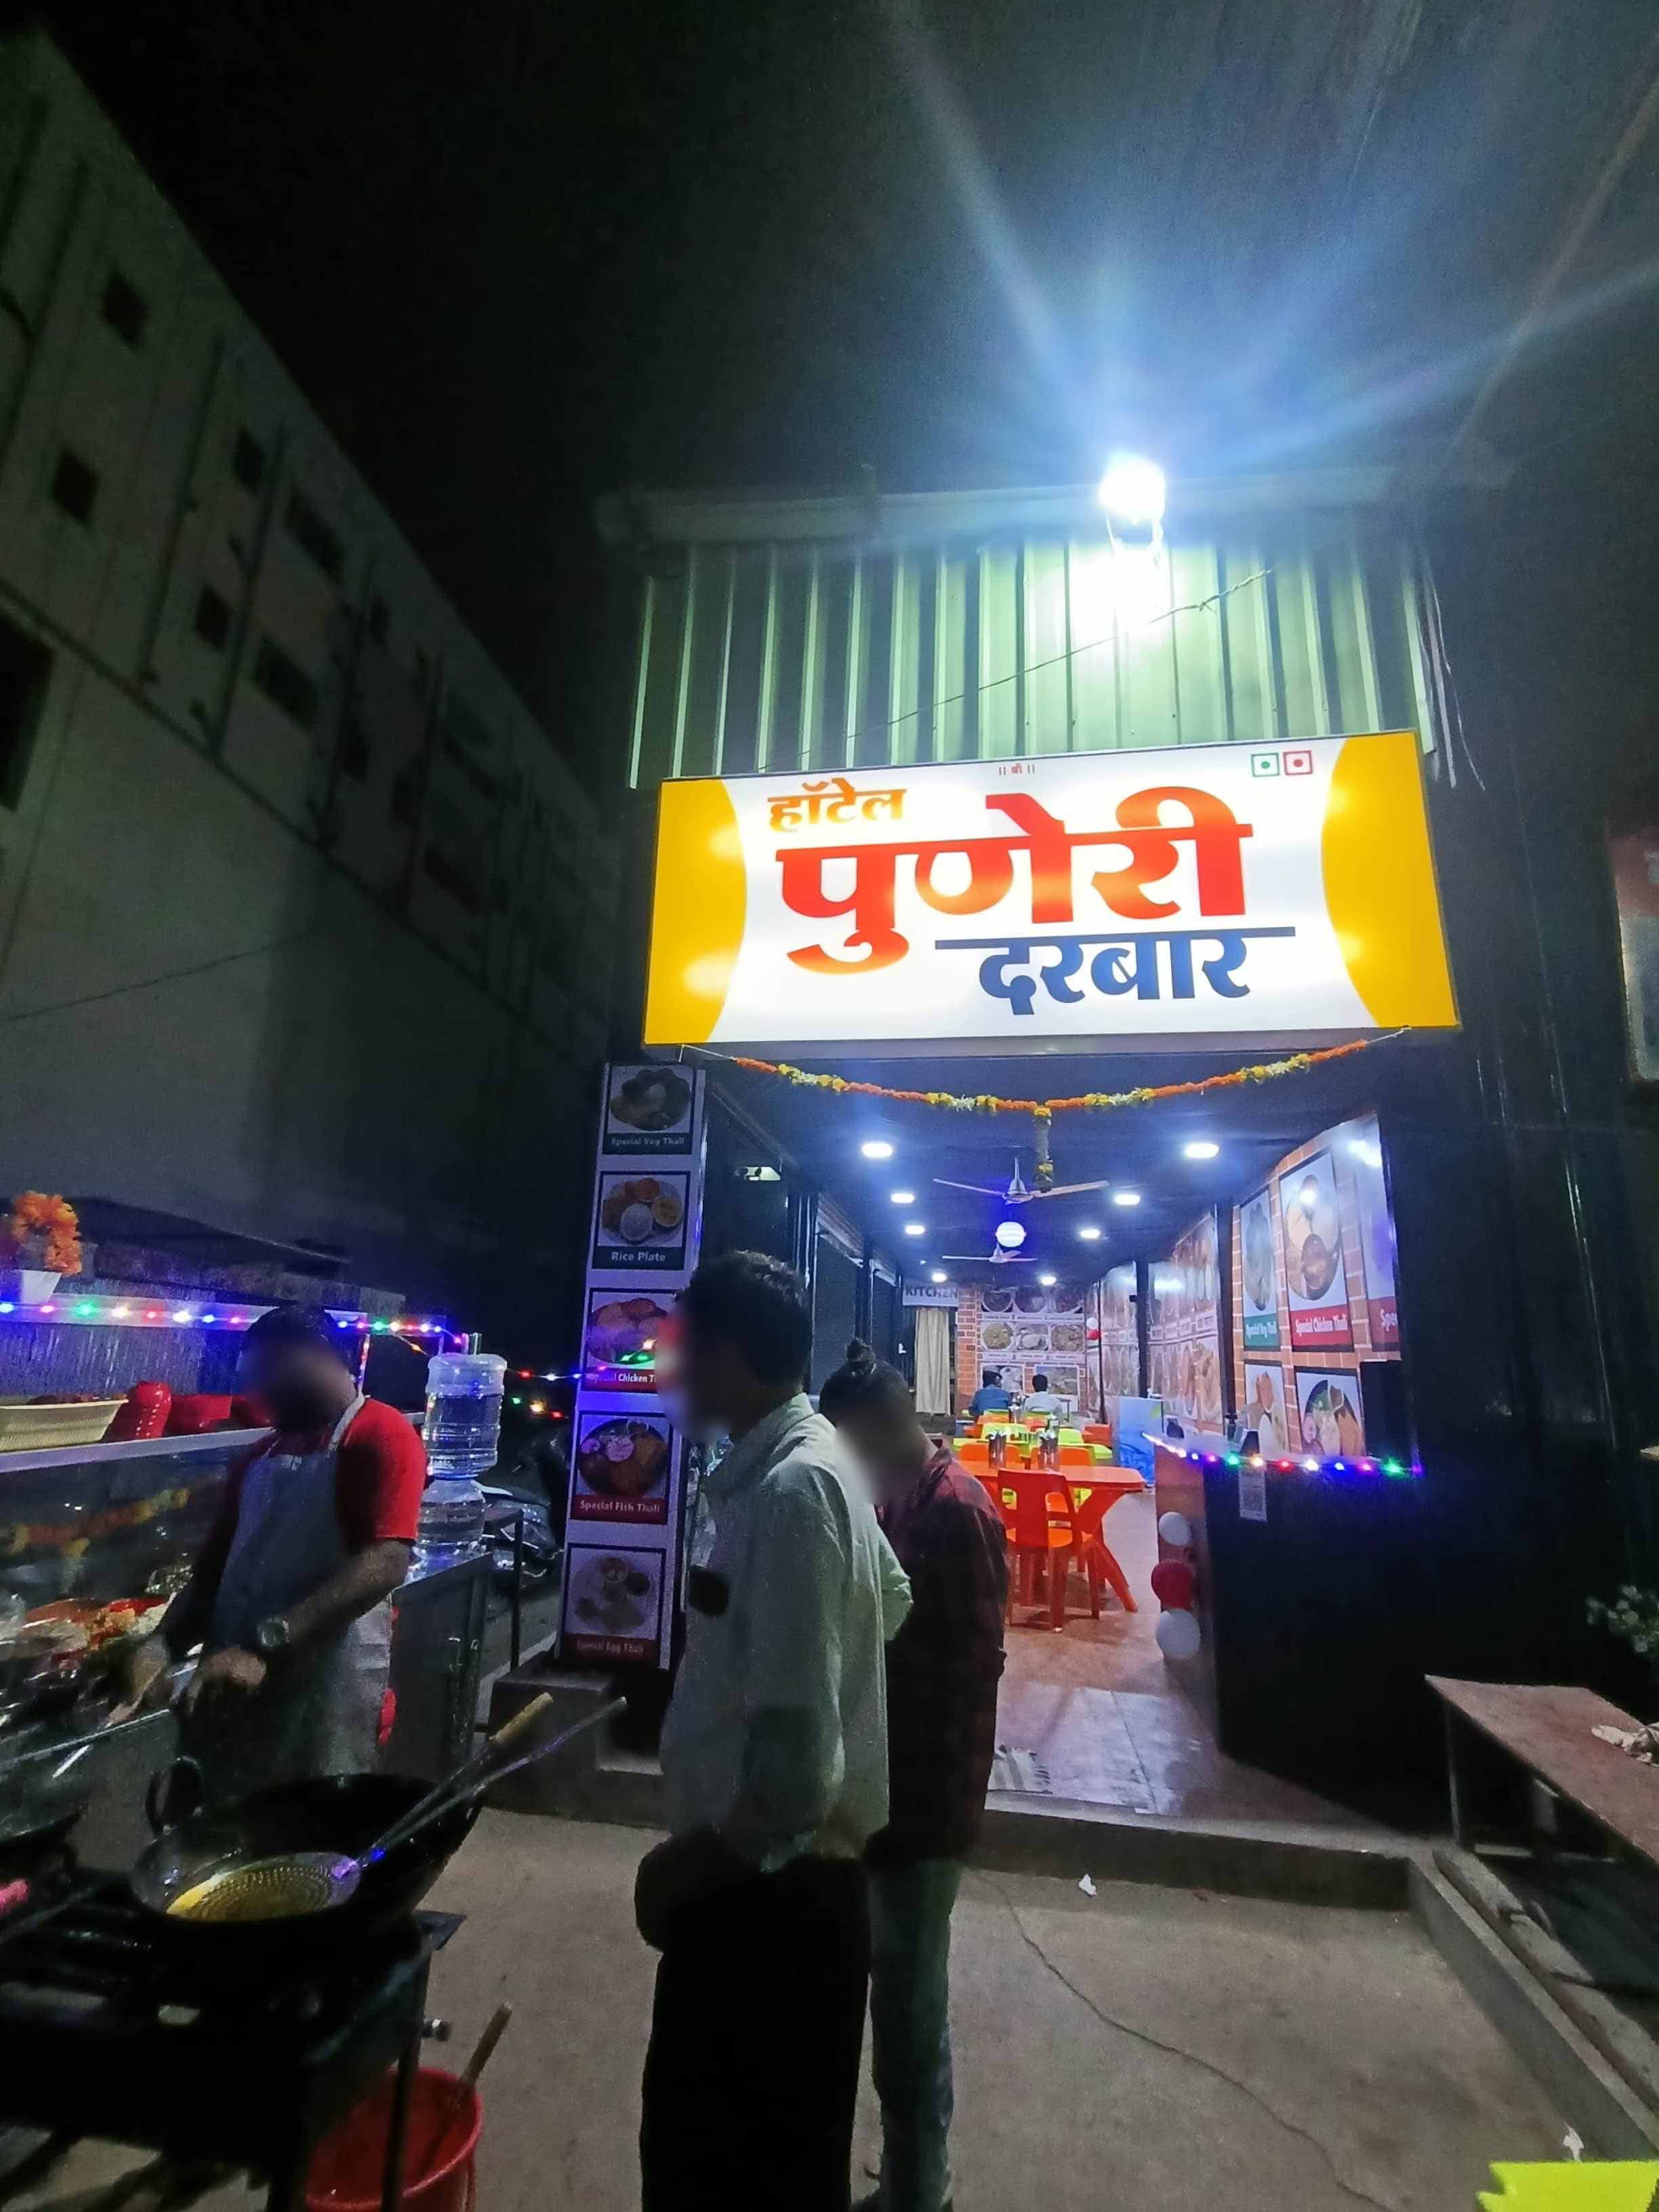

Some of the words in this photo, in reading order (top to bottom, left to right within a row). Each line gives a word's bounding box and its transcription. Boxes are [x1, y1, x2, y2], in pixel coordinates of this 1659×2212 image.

[769, 777, 906, 833] हॉटेल
[775, 786, 1254, 975] पुणेरी
[936, 926, 1296, 1016] दरबार
[611, 1251, 634, 1261] Rice
[638, 1251, 666, 1262] Plate
[905, 1286, 958, 1298] KITCHEN
[618, 1373, 648, 1382] Chicken
[579, 1500, 613, 1512] Special
[615, 1501, 634, 1512] Fish
